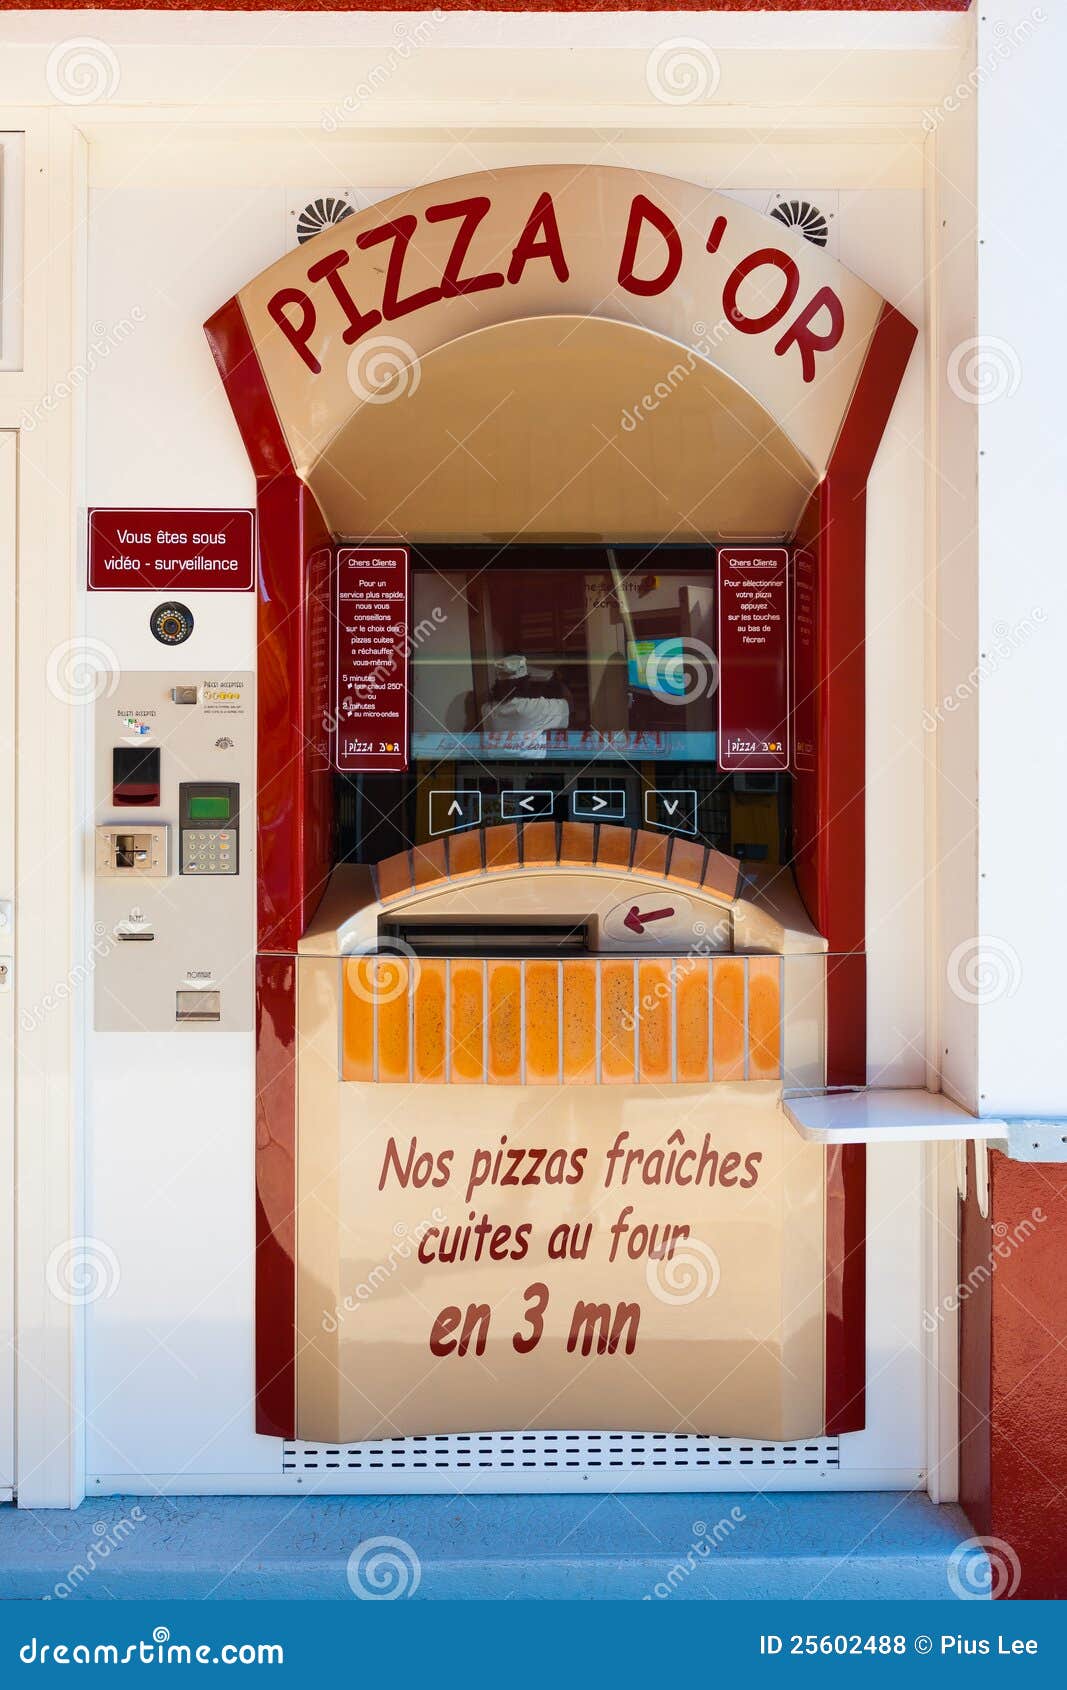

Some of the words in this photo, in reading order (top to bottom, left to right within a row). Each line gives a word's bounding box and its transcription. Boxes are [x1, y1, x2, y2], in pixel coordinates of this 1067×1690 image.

[266, 192, 569, 374] PIZZA
[617, 194, 845, 383] D'OR
[117, 529, 151, 545] Vous
[157, 529, 188, 545] êtes
[192, 532, 226, 545] sous
[104, 556, 141, 571] vidéo
[154, 555, 239, 571] surveillance
[348, 559, 370, 567] Chers
[372, 559, 397, 567] Clients
[729, 559, 751, 567] Chers
[753, 559, 777, 567] Clients
[358, 579, 376, 587] Pour
[365, 591, 380, 600] plus
[740, 603, 768, 611] appuyez
[354, 613, 391, 621] conseillons
[741, 613, 751, 621] les
[752, 613, 780, 621] touches
[351, 637, 372, 645] pizzas
[373, 636, 394, 644] cuites
[357, 647, 394, 655] réchauffer
[349, 674, 376, 682] minutes
[342, 702, 348, 710] 2
[349, 702, 376, 710] minutes
[378, 1136, 454, 1191] Nos
[465, 1135, 588, 1204] pizzas
[604, 1128, 763, 1189] fraîches
[417, 1211, 533, 1265] cuites
[547, 1222, 593, 1260] au
[608, 1205, 690, 1262] four
[429, 1301, 491, 1357] en
[512, 1281, 550, 1355] 3
[566, 1299, 642, 1357] mn
